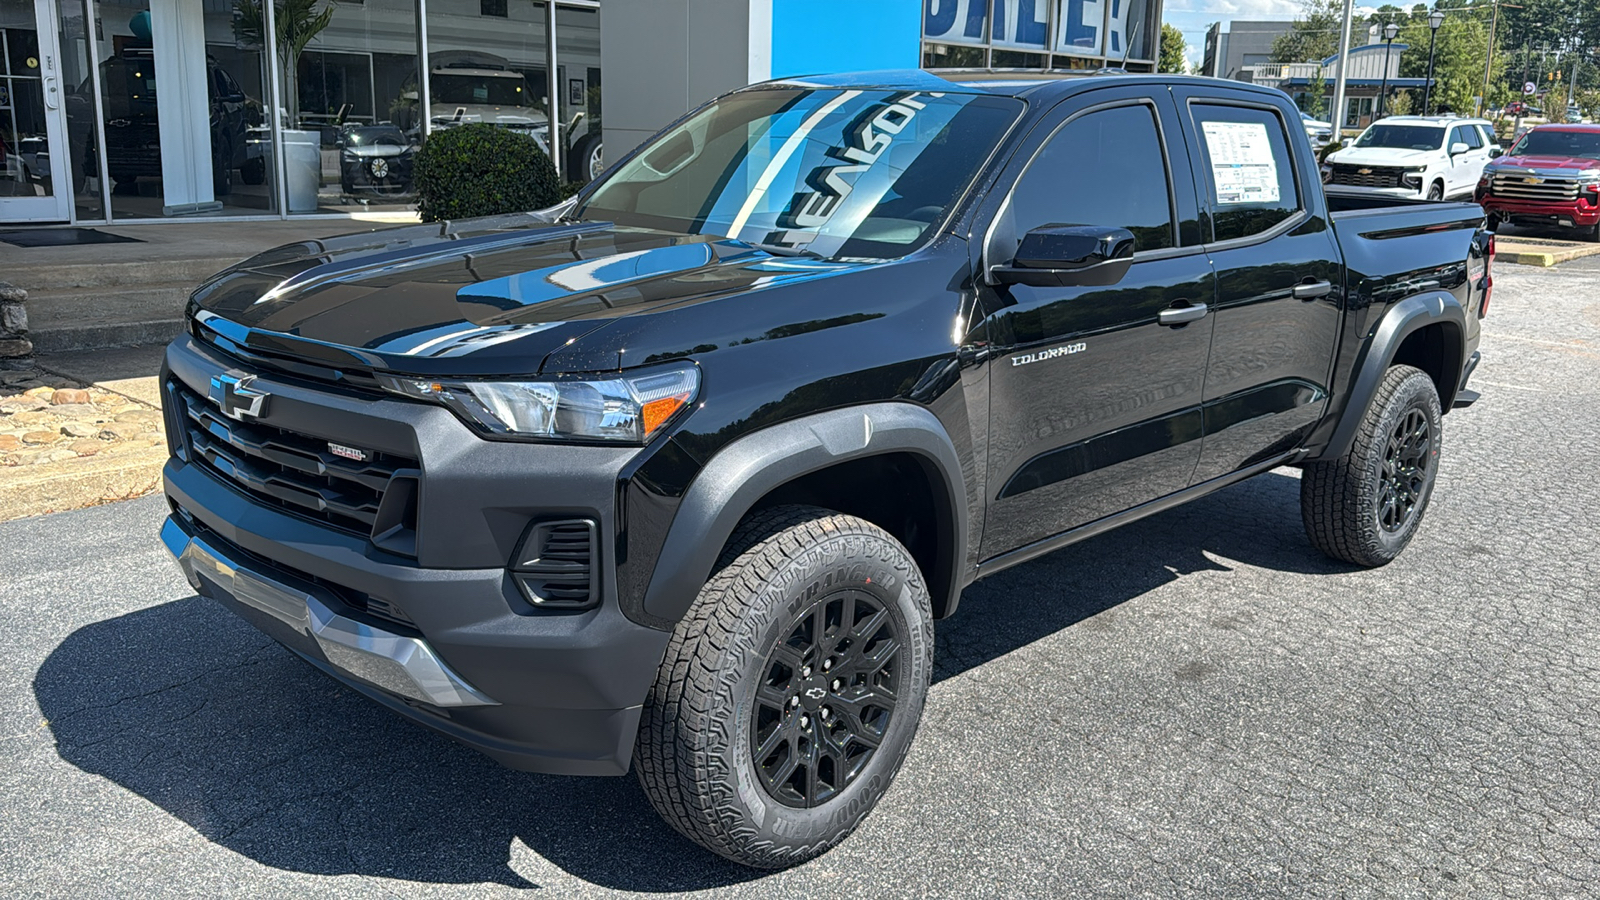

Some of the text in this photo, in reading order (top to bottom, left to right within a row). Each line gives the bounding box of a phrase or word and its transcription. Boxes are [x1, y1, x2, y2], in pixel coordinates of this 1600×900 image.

[1011, 342, 1087, 366] COLORADO
[787, 560, 896, 617] WRANGLER
[911, 624, 923, 695] TERRITORY
[772, 773, 881, 840] GOODYEAR
